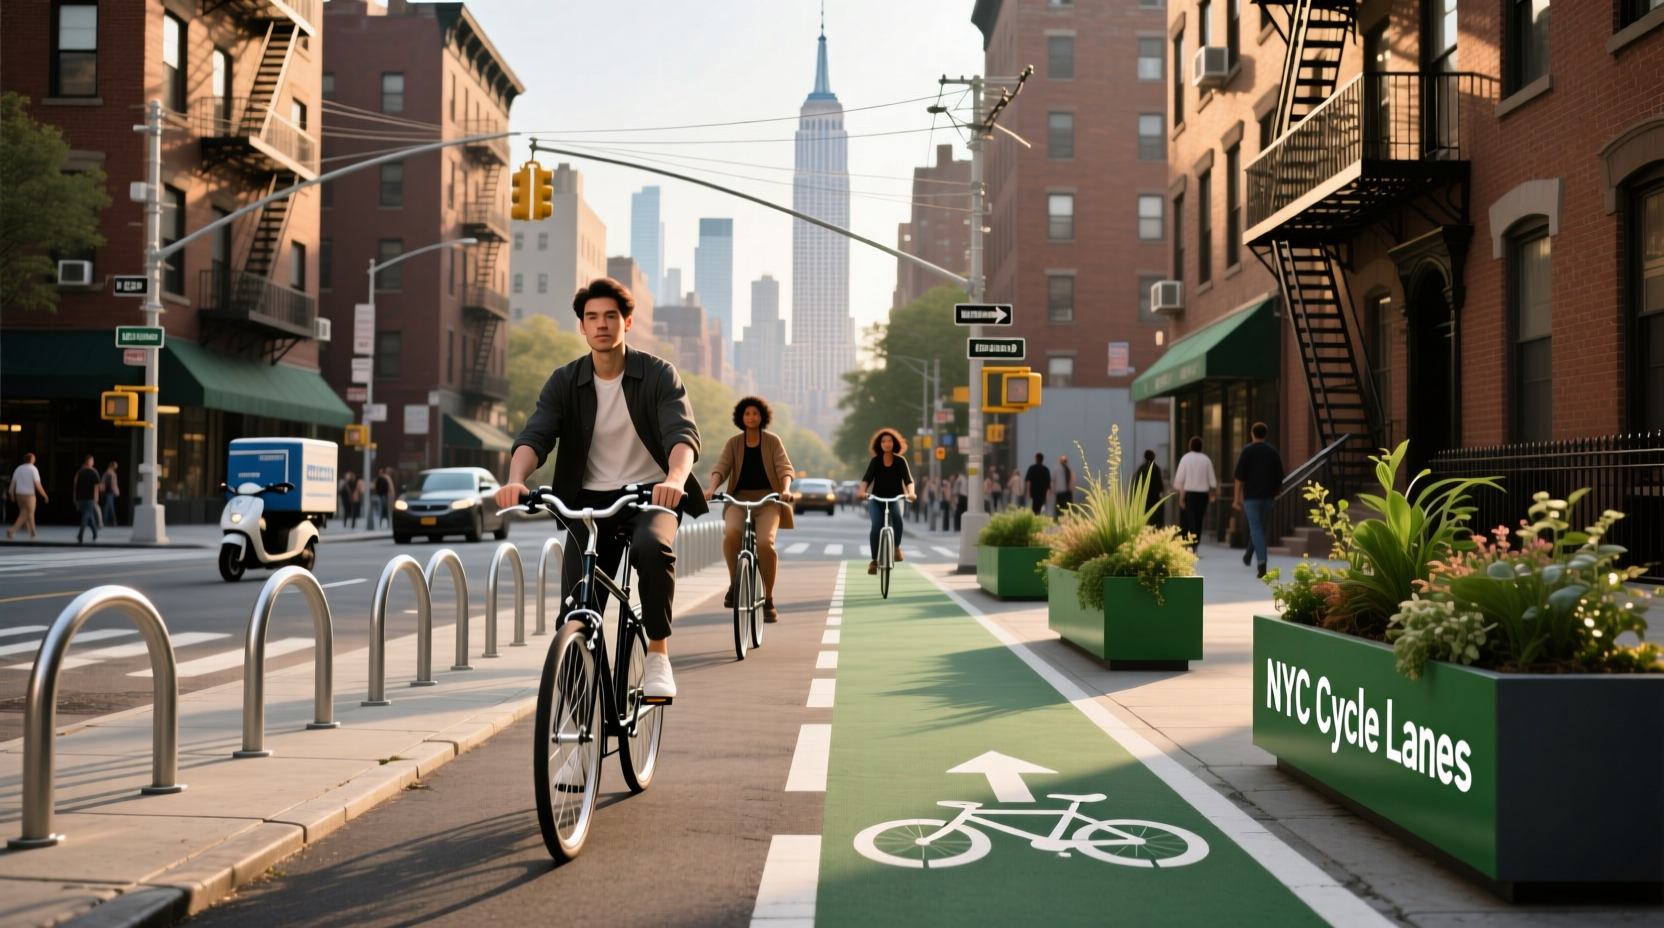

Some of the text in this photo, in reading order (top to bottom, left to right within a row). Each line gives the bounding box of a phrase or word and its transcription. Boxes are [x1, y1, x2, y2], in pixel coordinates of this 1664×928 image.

[1267, 658, 1472, 792] NYC Cycle Lanes
